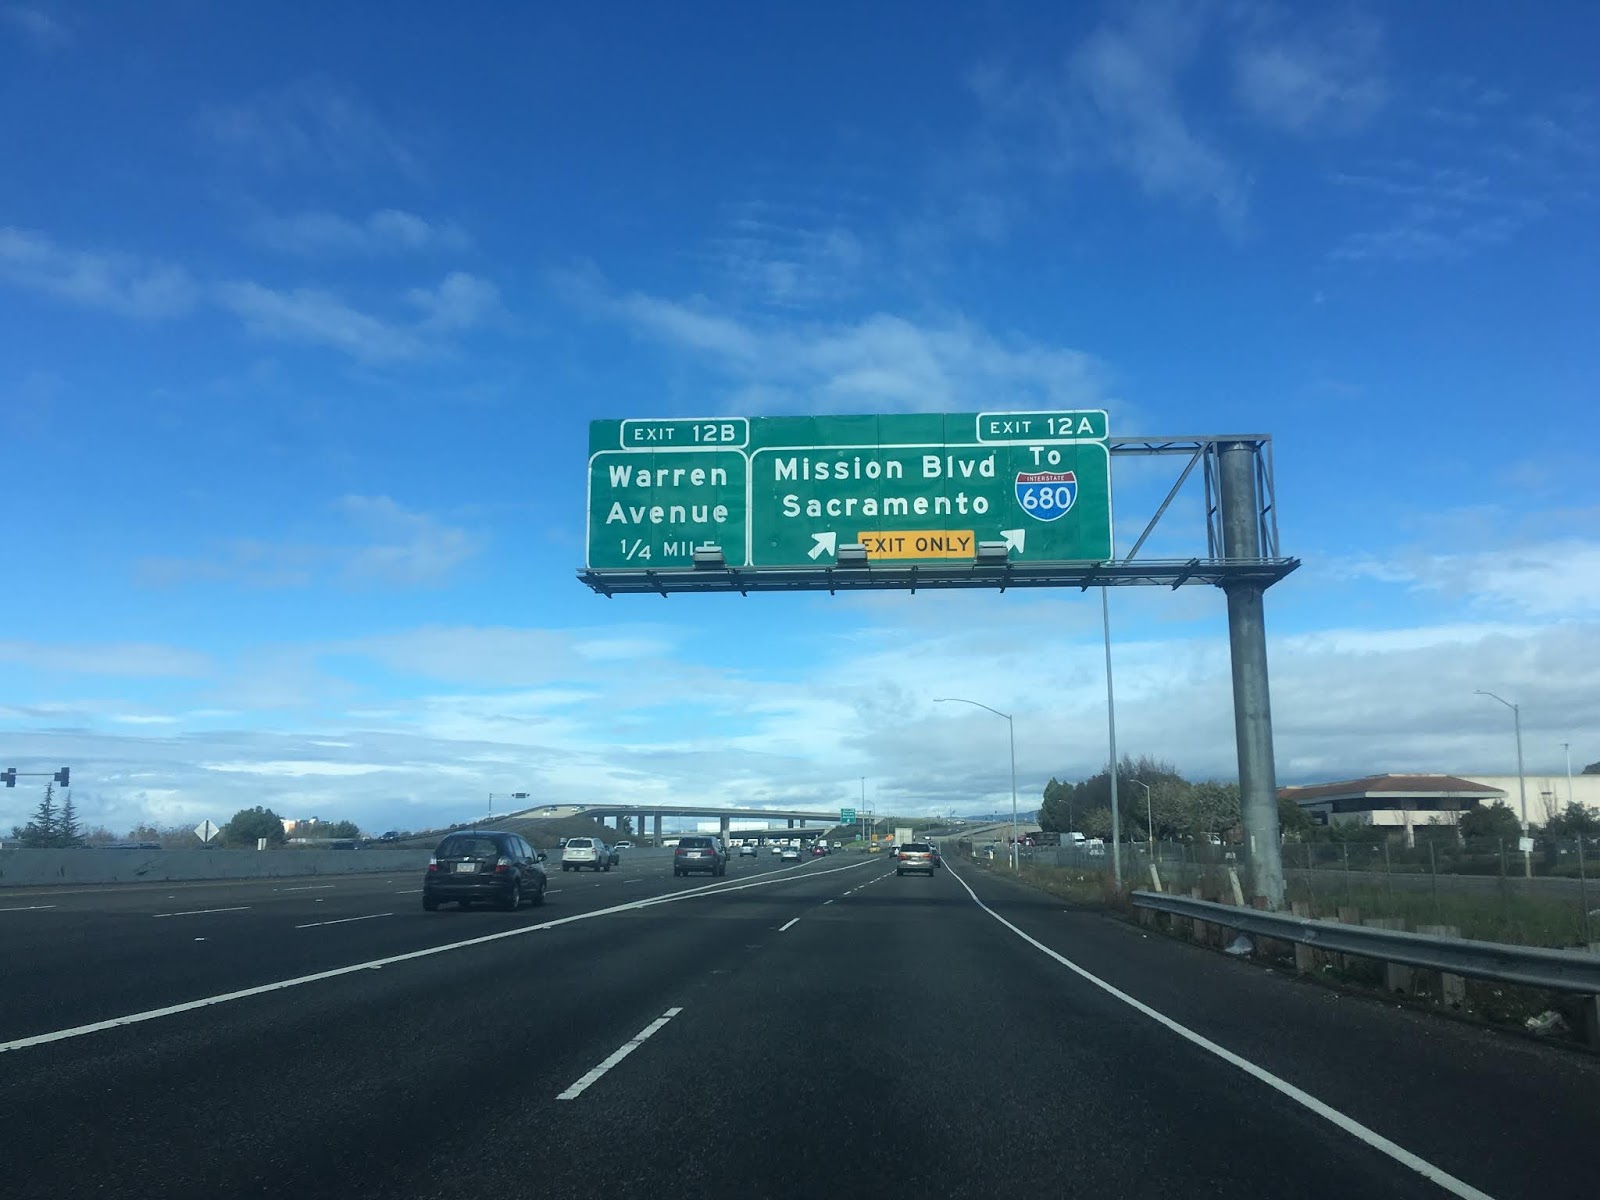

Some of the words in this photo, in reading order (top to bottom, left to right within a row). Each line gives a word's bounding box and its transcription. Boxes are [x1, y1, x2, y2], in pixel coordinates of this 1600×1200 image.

[634, 427, 674, 441] EXIT
[692, 424, 735, 442] 12B
[989, 421, 1032, 434] EXIT
[1047, 416, 1094, 435] 12A
[1029, 446, 1061, 466] To
[609, 465, 727, 488] Warren
[775, 457, 903, 482] Mission
[922, 455, 996, 478] Blvd
[783, 492, 990, 517] Sacramento
[1022, 486, 1071, 510] 680
[606, 501, 728, 525] Avenue
[620, 538, 652, 561] 1/4
[862, 538, 905, 553] EXIT
[915, 537, 971, 552] ONLY
